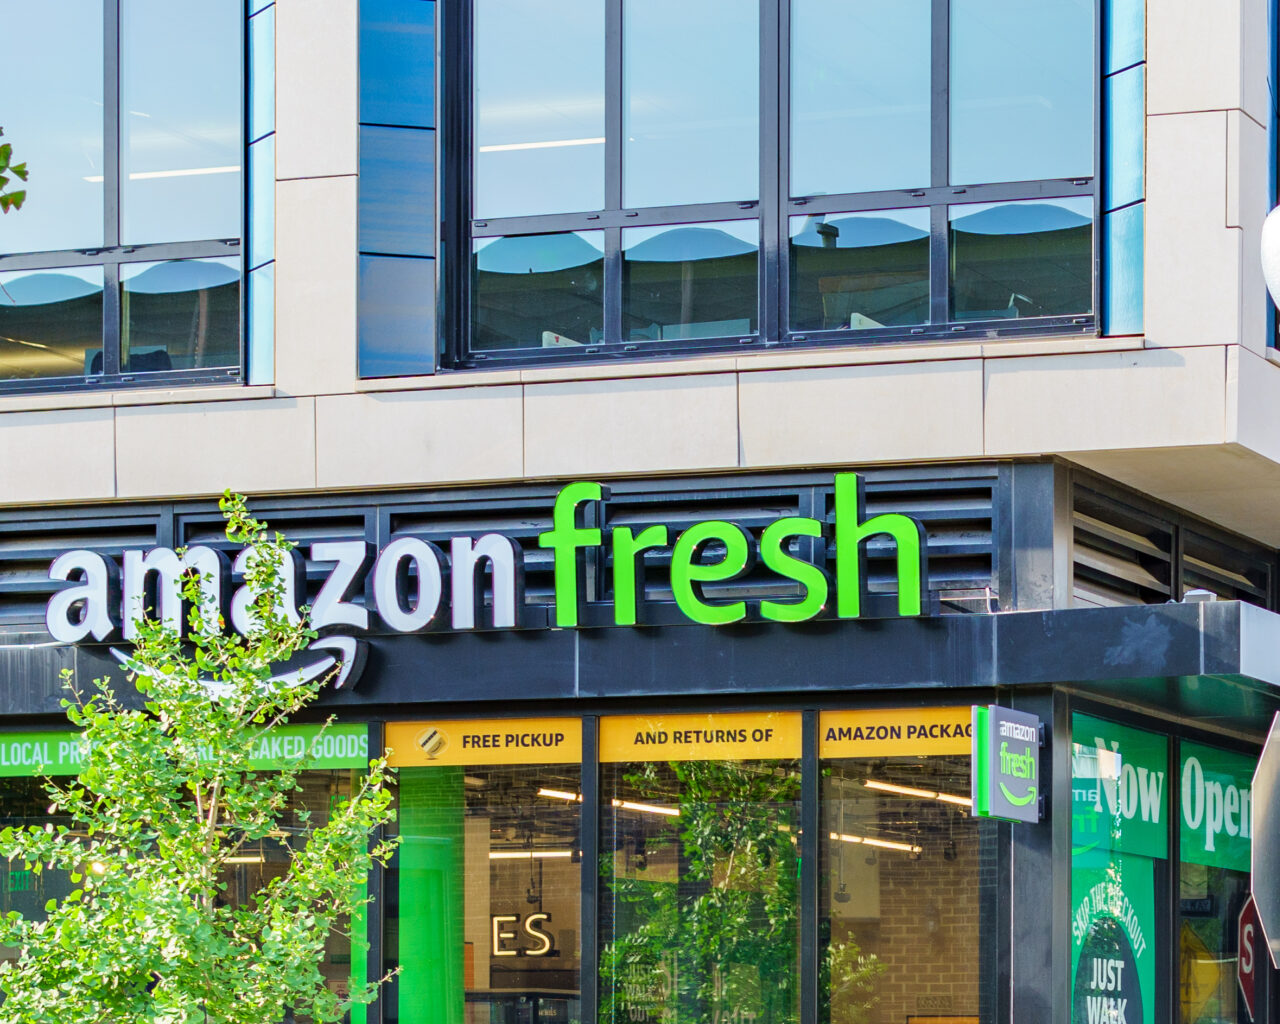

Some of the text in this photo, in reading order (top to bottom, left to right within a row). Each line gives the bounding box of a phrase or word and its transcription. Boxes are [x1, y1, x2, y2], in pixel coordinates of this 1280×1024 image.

[46, 472, 921, 643] amazon fresh
[462, 732, 564, 749] FREE PICKUP
[634, 728, 774, 745] AND RETURNS OF
[825, 726, 902, 742] AMAZON
[1000, 720, 1036, 743] amazon
[1, 741, 53, 766] LOCAL
[312, 733, 368, 759] GOODS
[1000, 741, 1036, 780] fresh
[1093, 735, 1165, 824] Now
[9, 870, 31, 892] EXIT
[1072, 896, 1090, 946] SKIP
[1089, 881, 1109, 915] THE
[492, 913, 551, 956] ES
[1090, 957, 1125, 991] JUST
